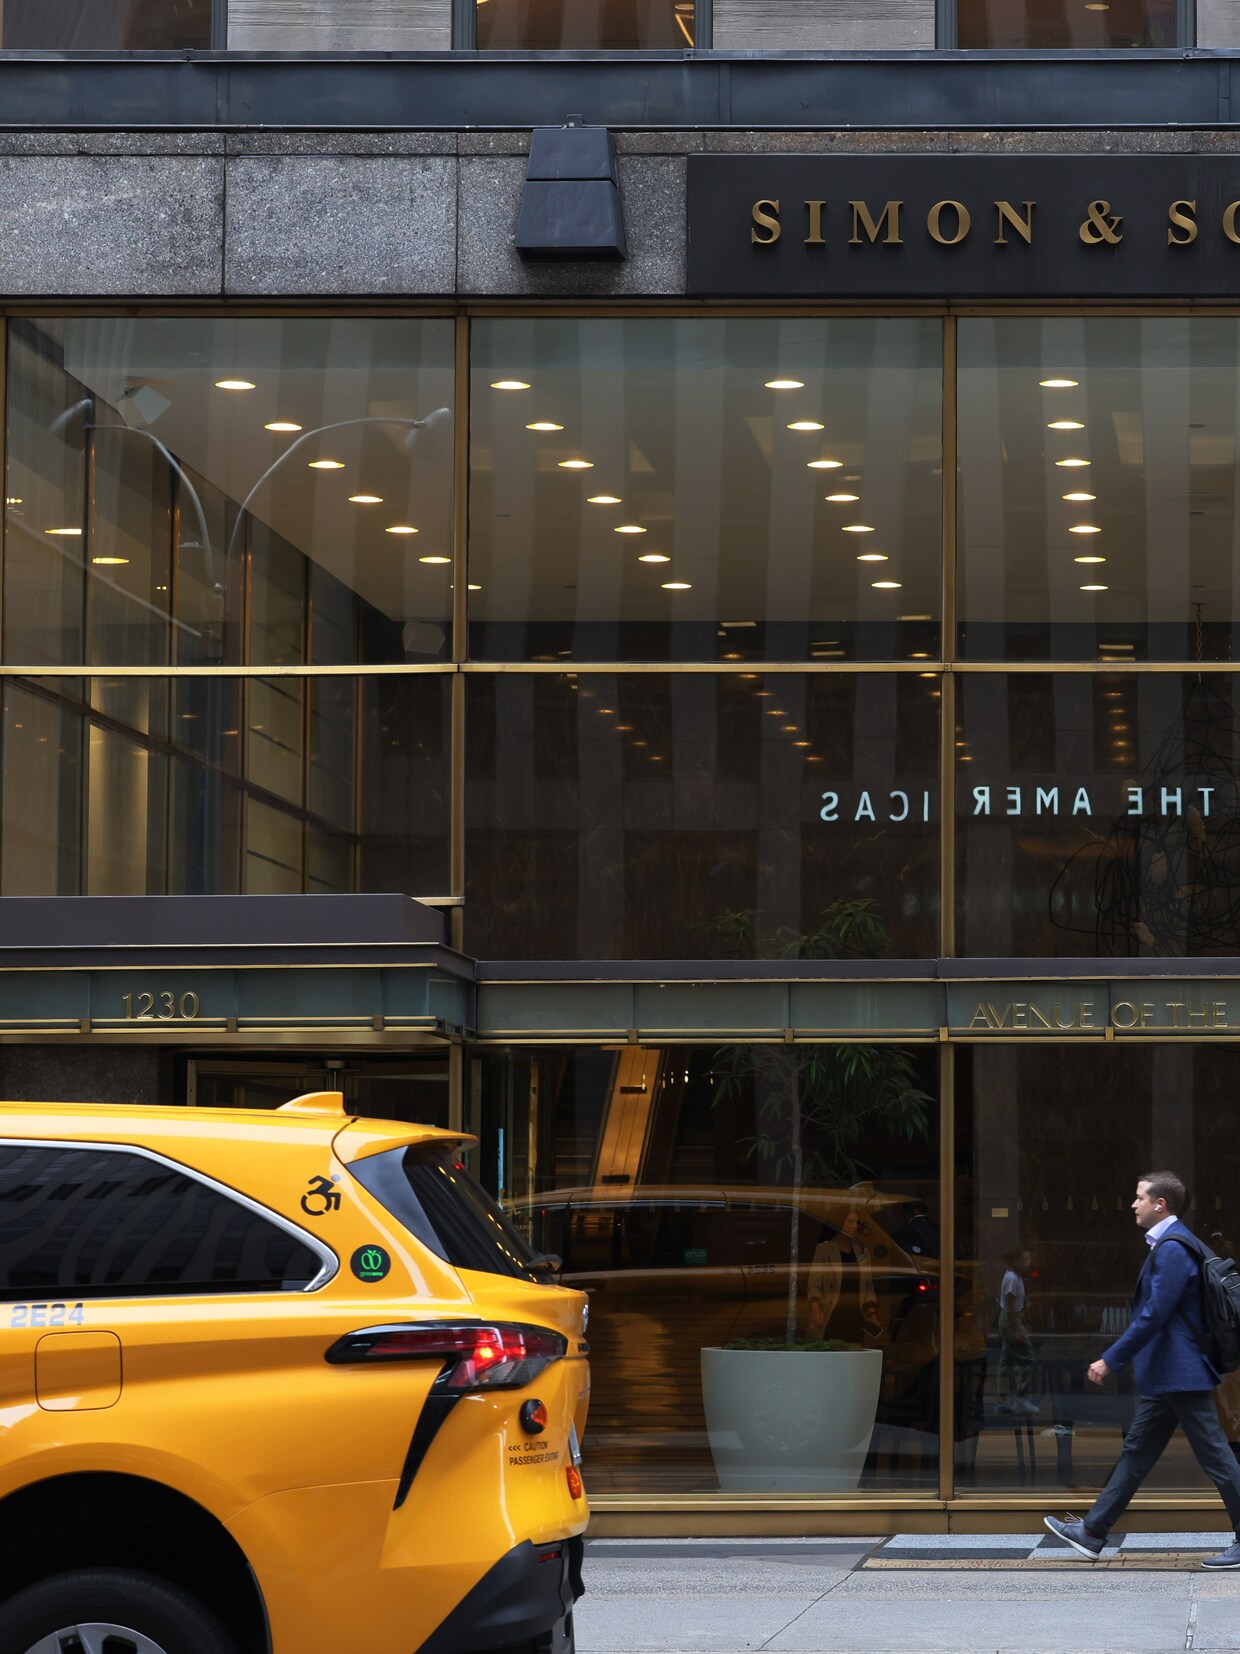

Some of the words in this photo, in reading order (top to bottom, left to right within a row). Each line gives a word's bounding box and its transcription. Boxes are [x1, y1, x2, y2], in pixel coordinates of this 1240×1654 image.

[751, 199, 1036, 245] SIMON
[1079, 200, 1123, 245] &
[122, 991, 199, 1019] 1230
[970, 1002, 1095, 1028] AVENUE
[1111, 1002, 1155, 1027] OF
[1166, 1002, 1228, 1027] THE
[11, 1303, 84, 1328] 2E24
[524, 1441, 548, 1452] CAUTION
[509, 1453, 544, 1466] PASSENGER
